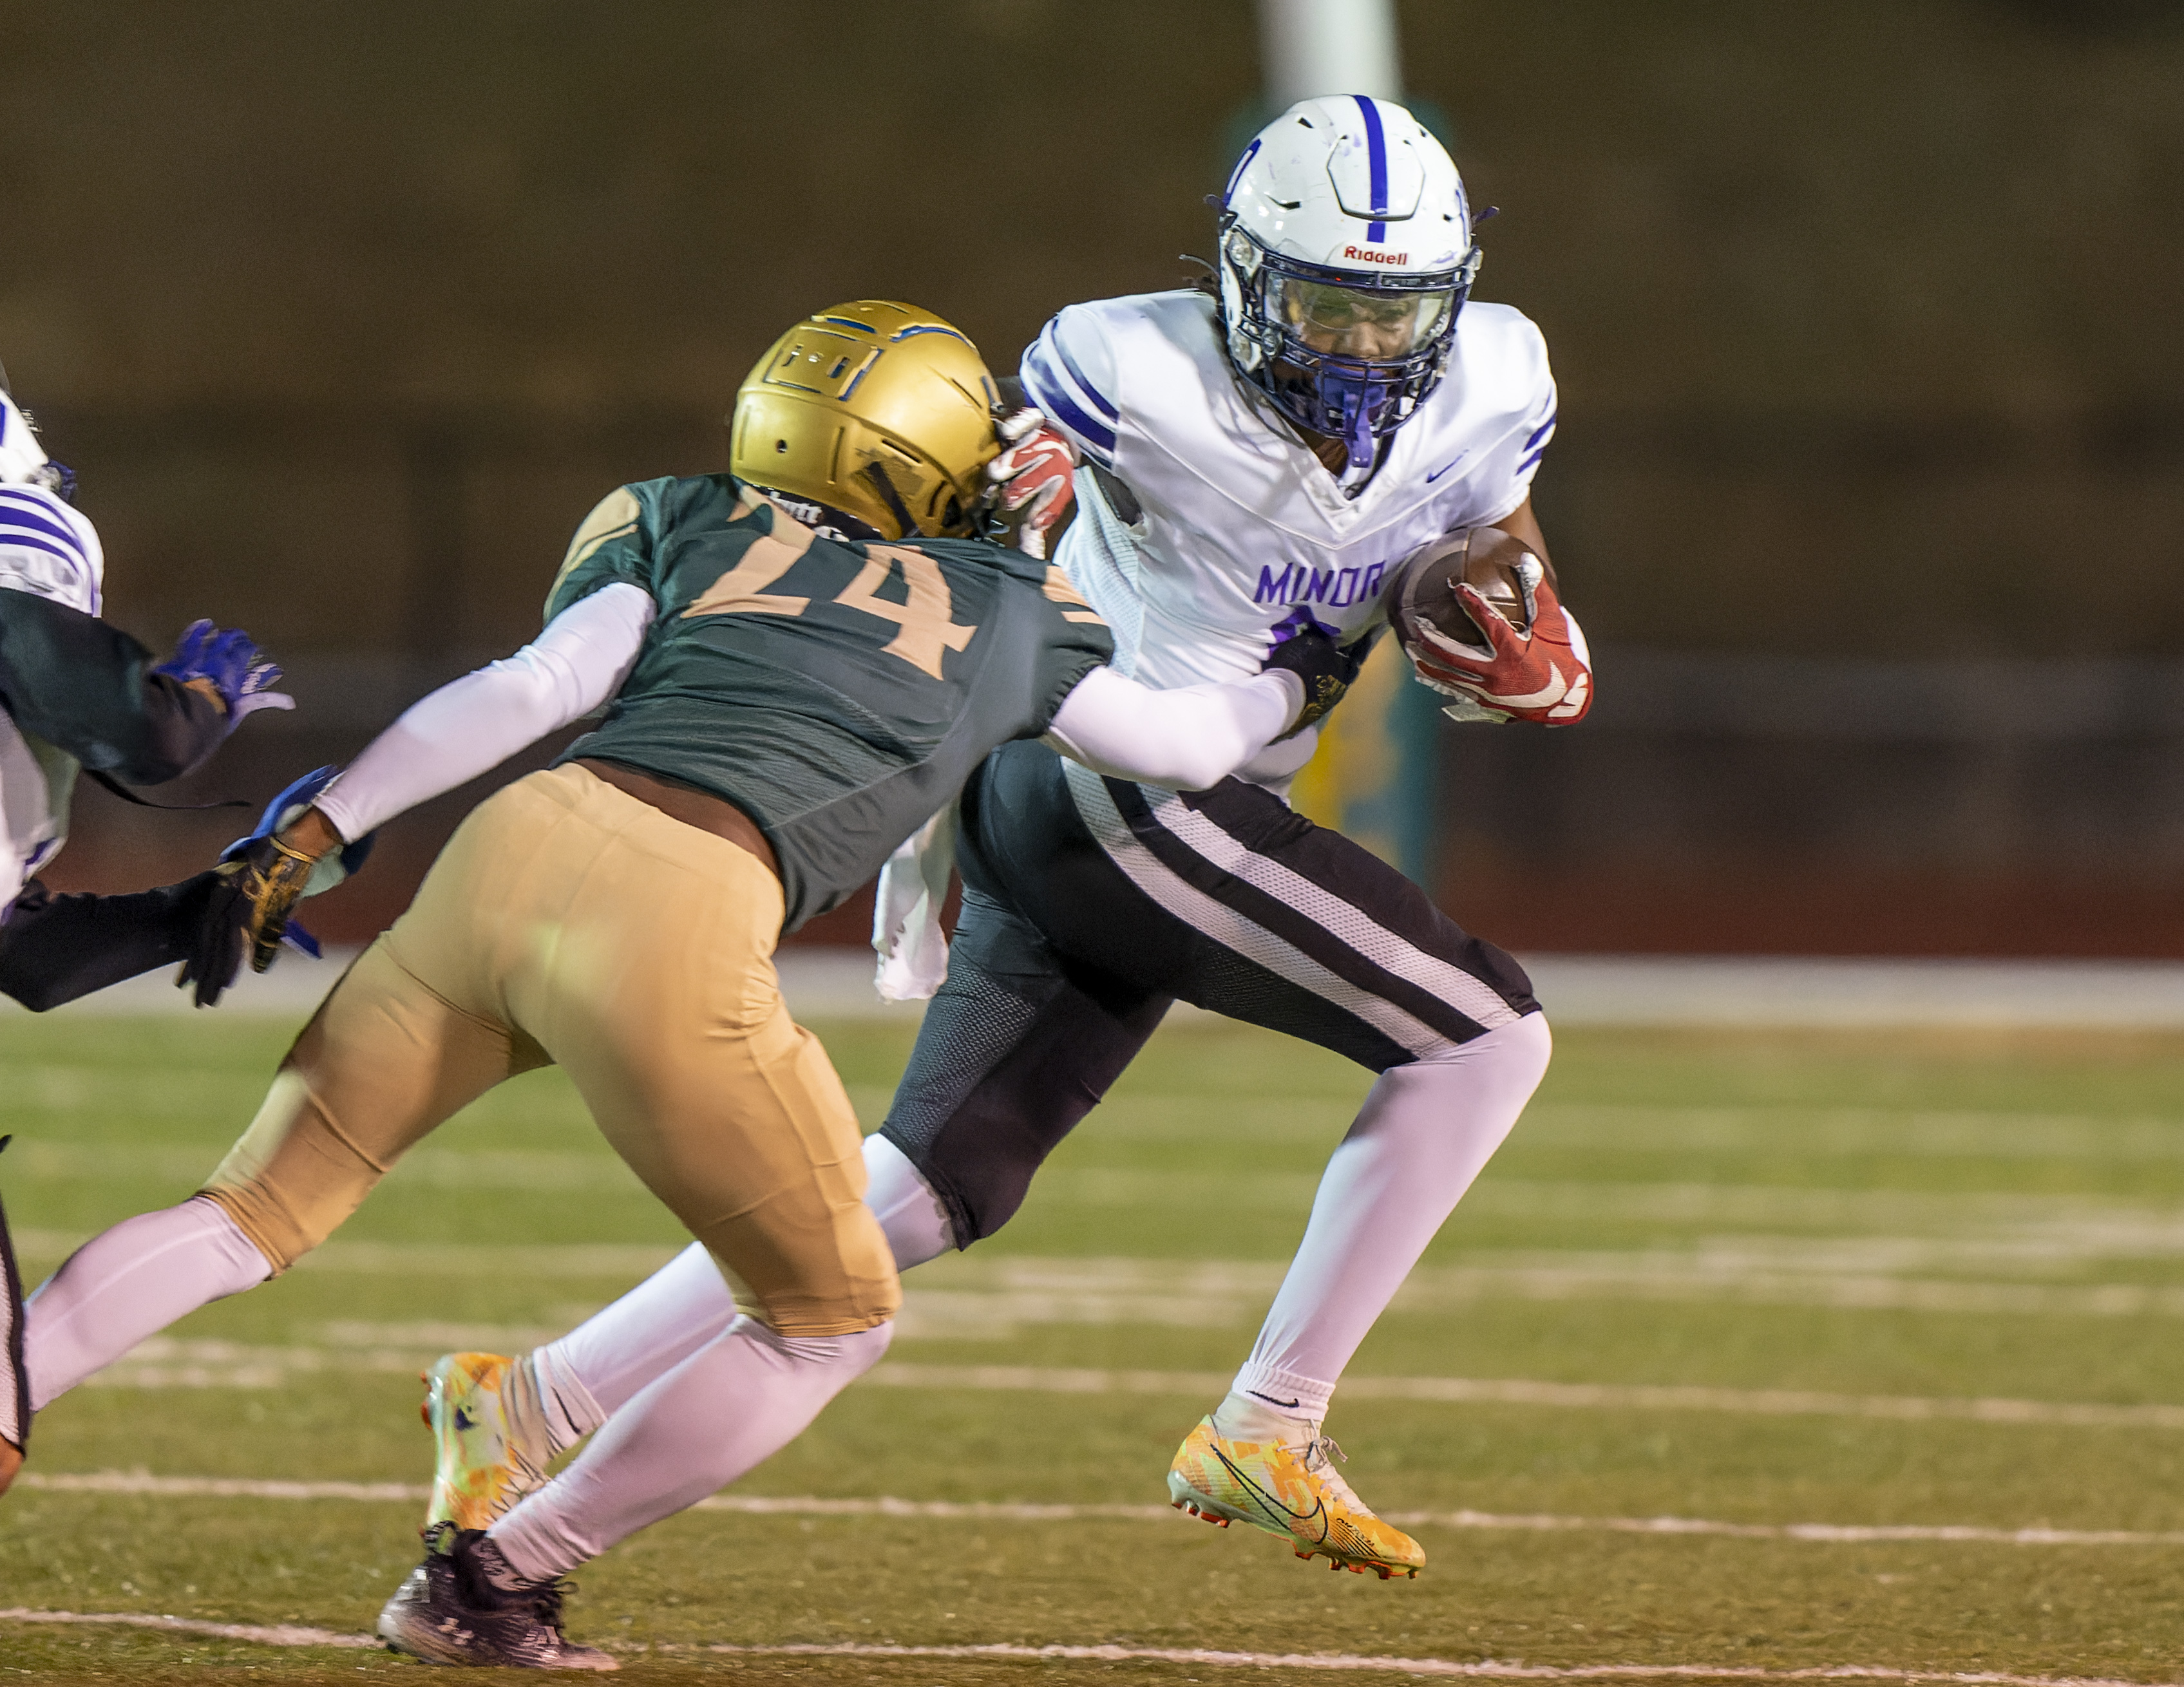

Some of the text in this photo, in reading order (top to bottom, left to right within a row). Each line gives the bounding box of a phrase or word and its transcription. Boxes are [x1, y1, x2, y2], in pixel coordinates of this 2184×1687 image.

[1344, 246, 1408, 265] Riddell
[680, 485, 978, 681] 24
[1253, 560, 1386, 607] MINOR
